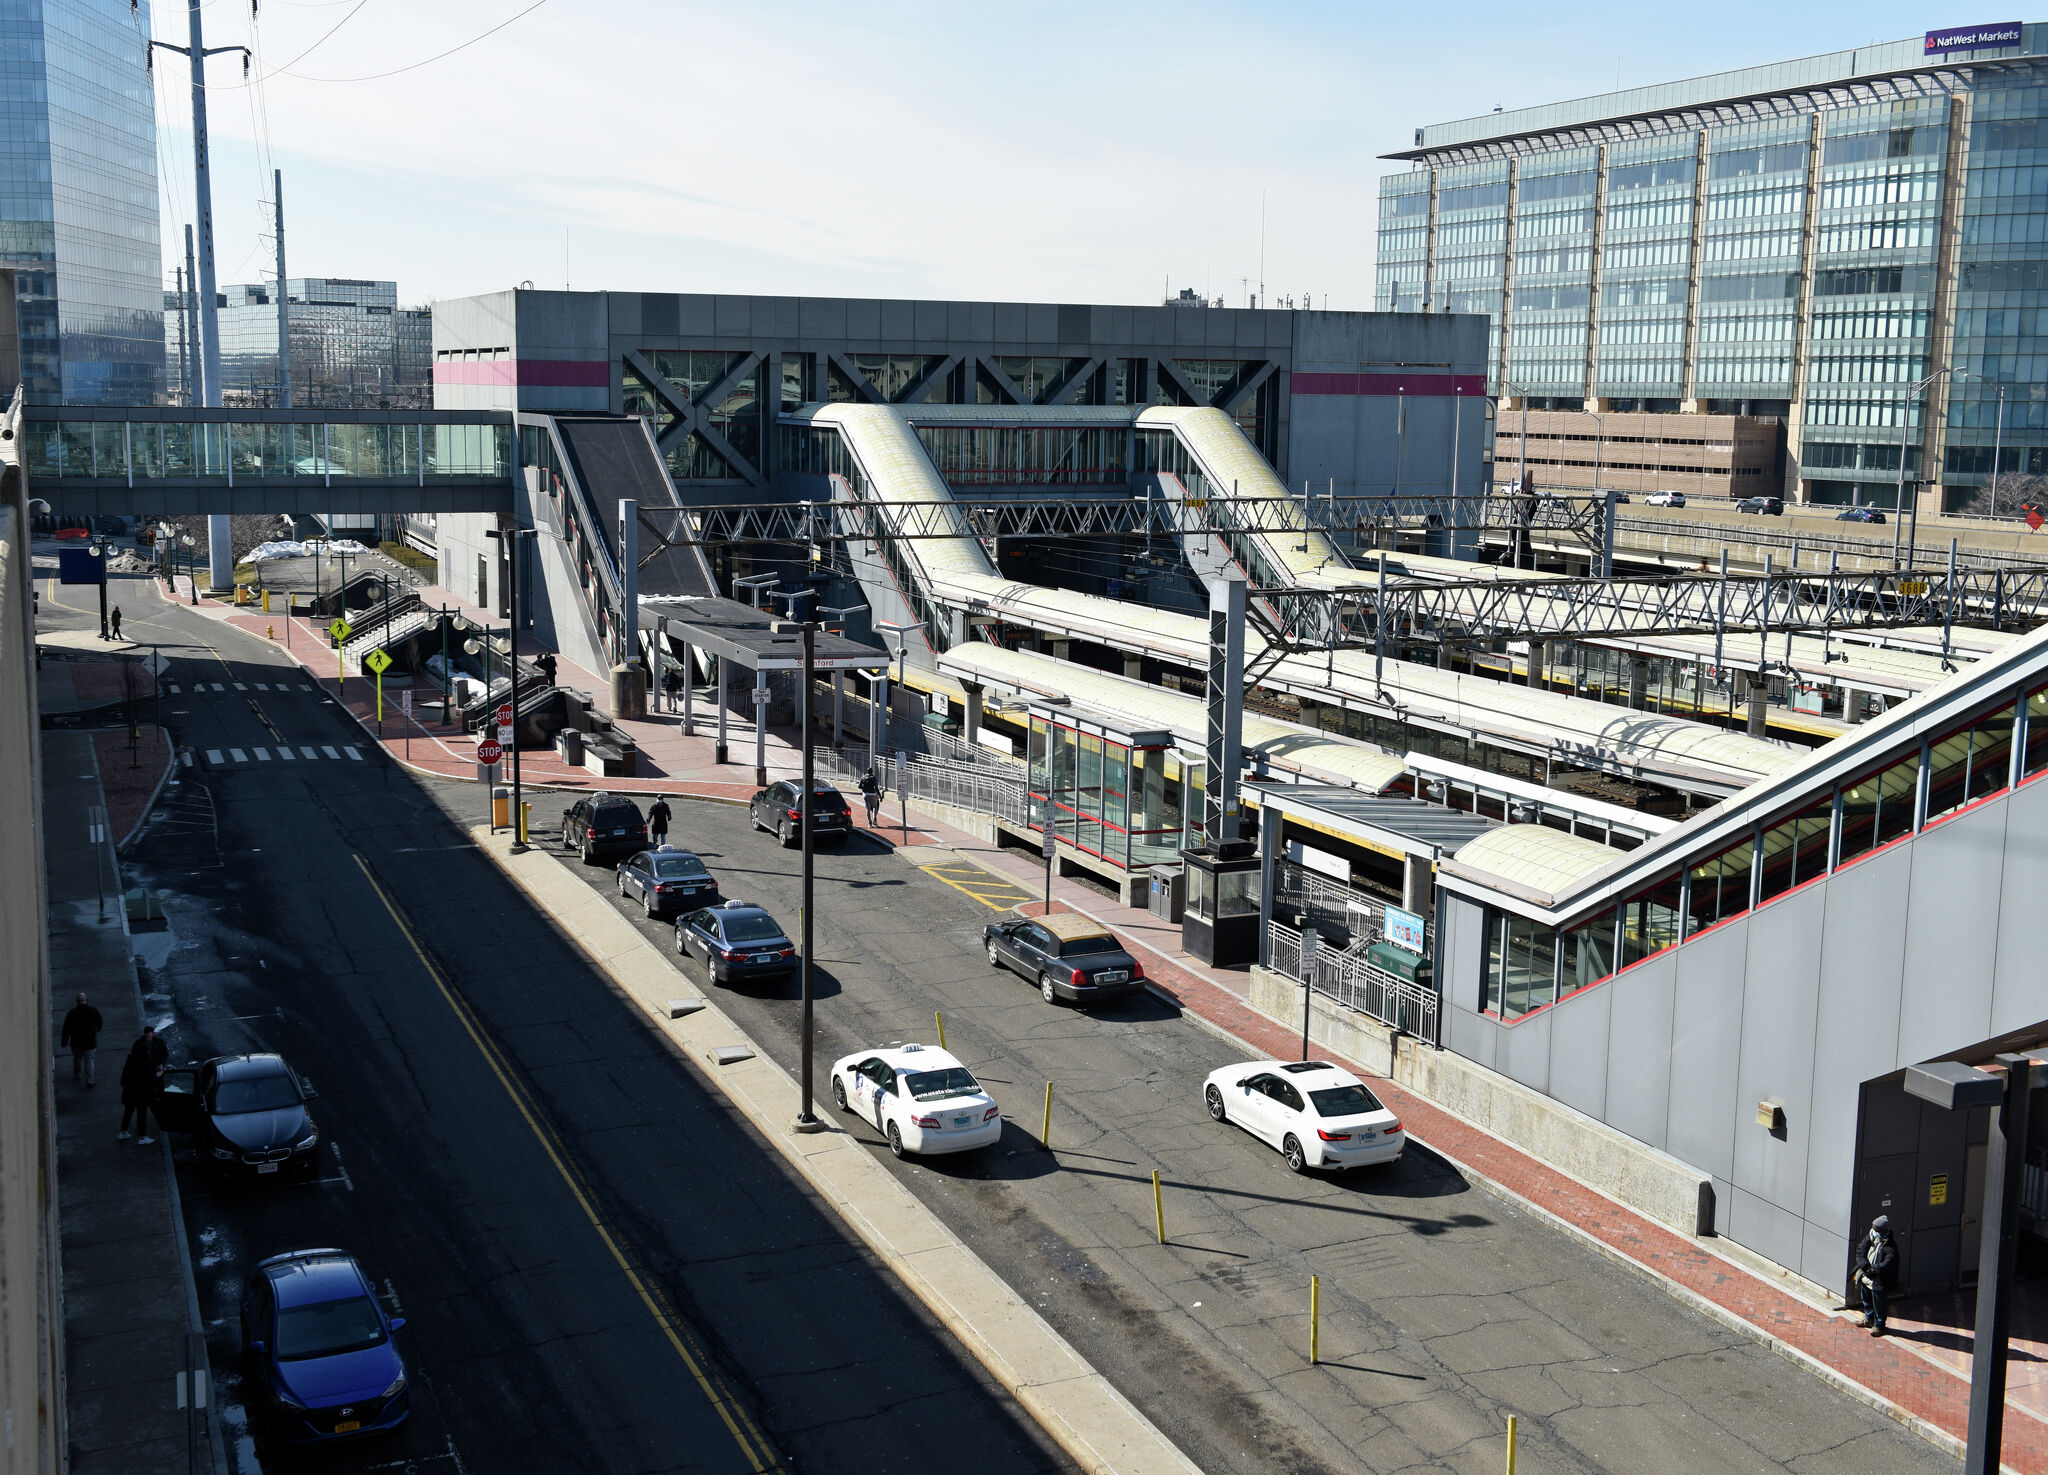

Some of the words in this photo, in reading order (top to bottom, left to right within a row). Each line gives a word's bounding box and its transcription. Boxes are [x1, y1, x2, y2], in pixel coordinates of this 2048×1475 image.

[1936, 33, 1976, 48] NatWest
[1978, 30, 2020, 43] Markets
[1900, 582, 1925, 594] 368B
[1474, 653, 1497, 665] Stamford
[479, 746, 501, 757] STOP
